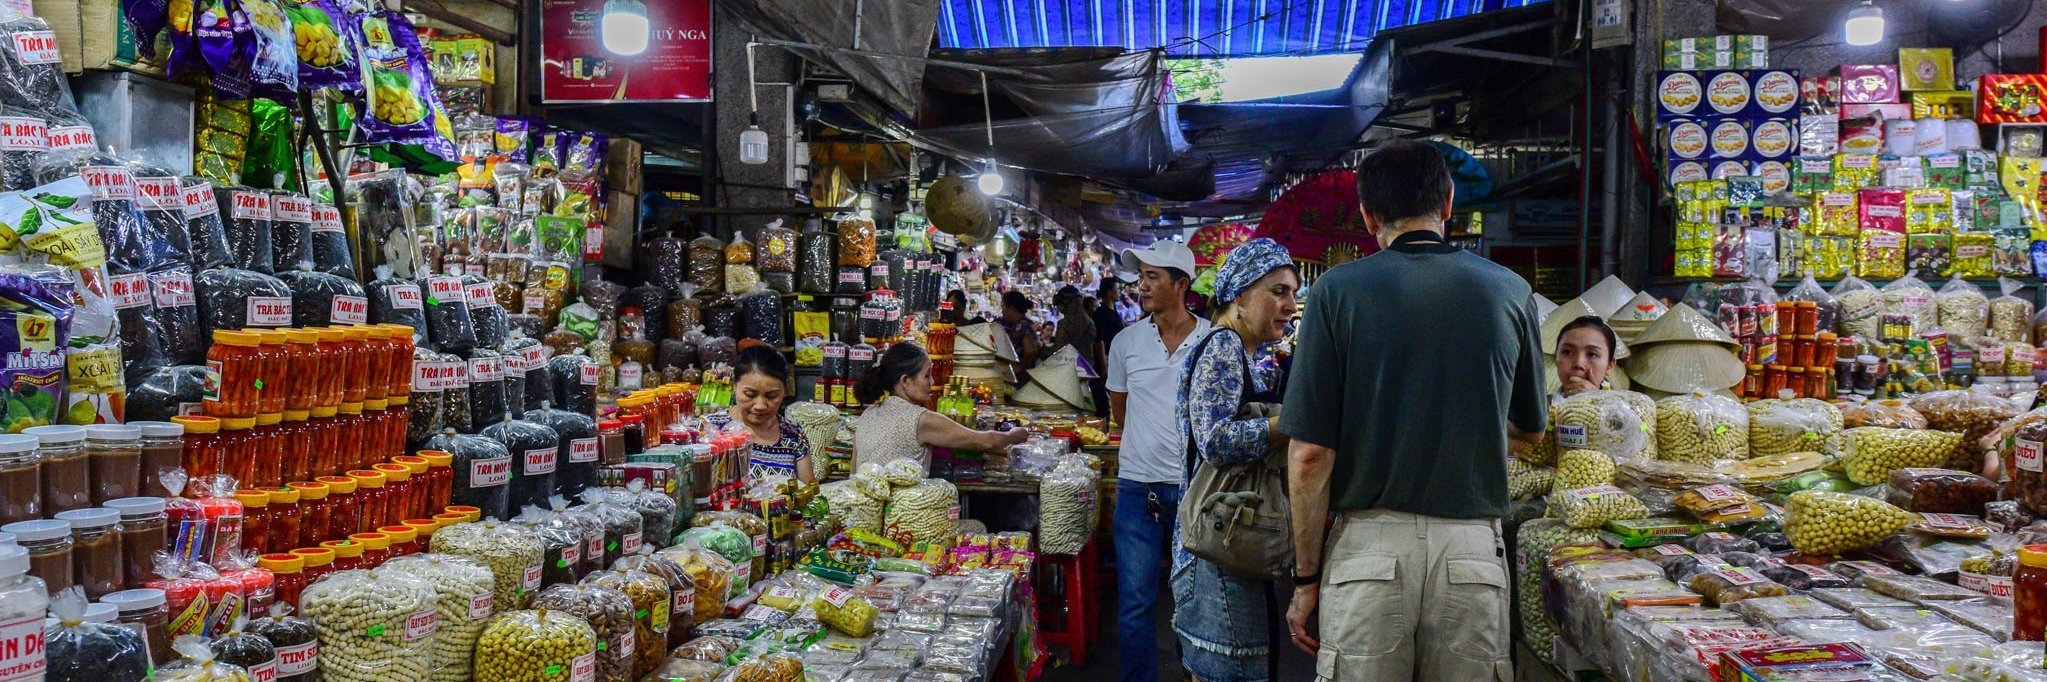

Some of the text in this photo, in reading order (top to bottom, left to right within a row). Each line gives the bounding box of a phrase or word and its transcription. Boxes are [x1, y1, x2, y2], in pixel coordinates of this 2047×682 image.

[678, 29, 707, 40] NGA
[257, 302, 272, 315] TRÀ
[477, 461, 492, 475] TRÀ
[281, 650, 305, 665] TIM
